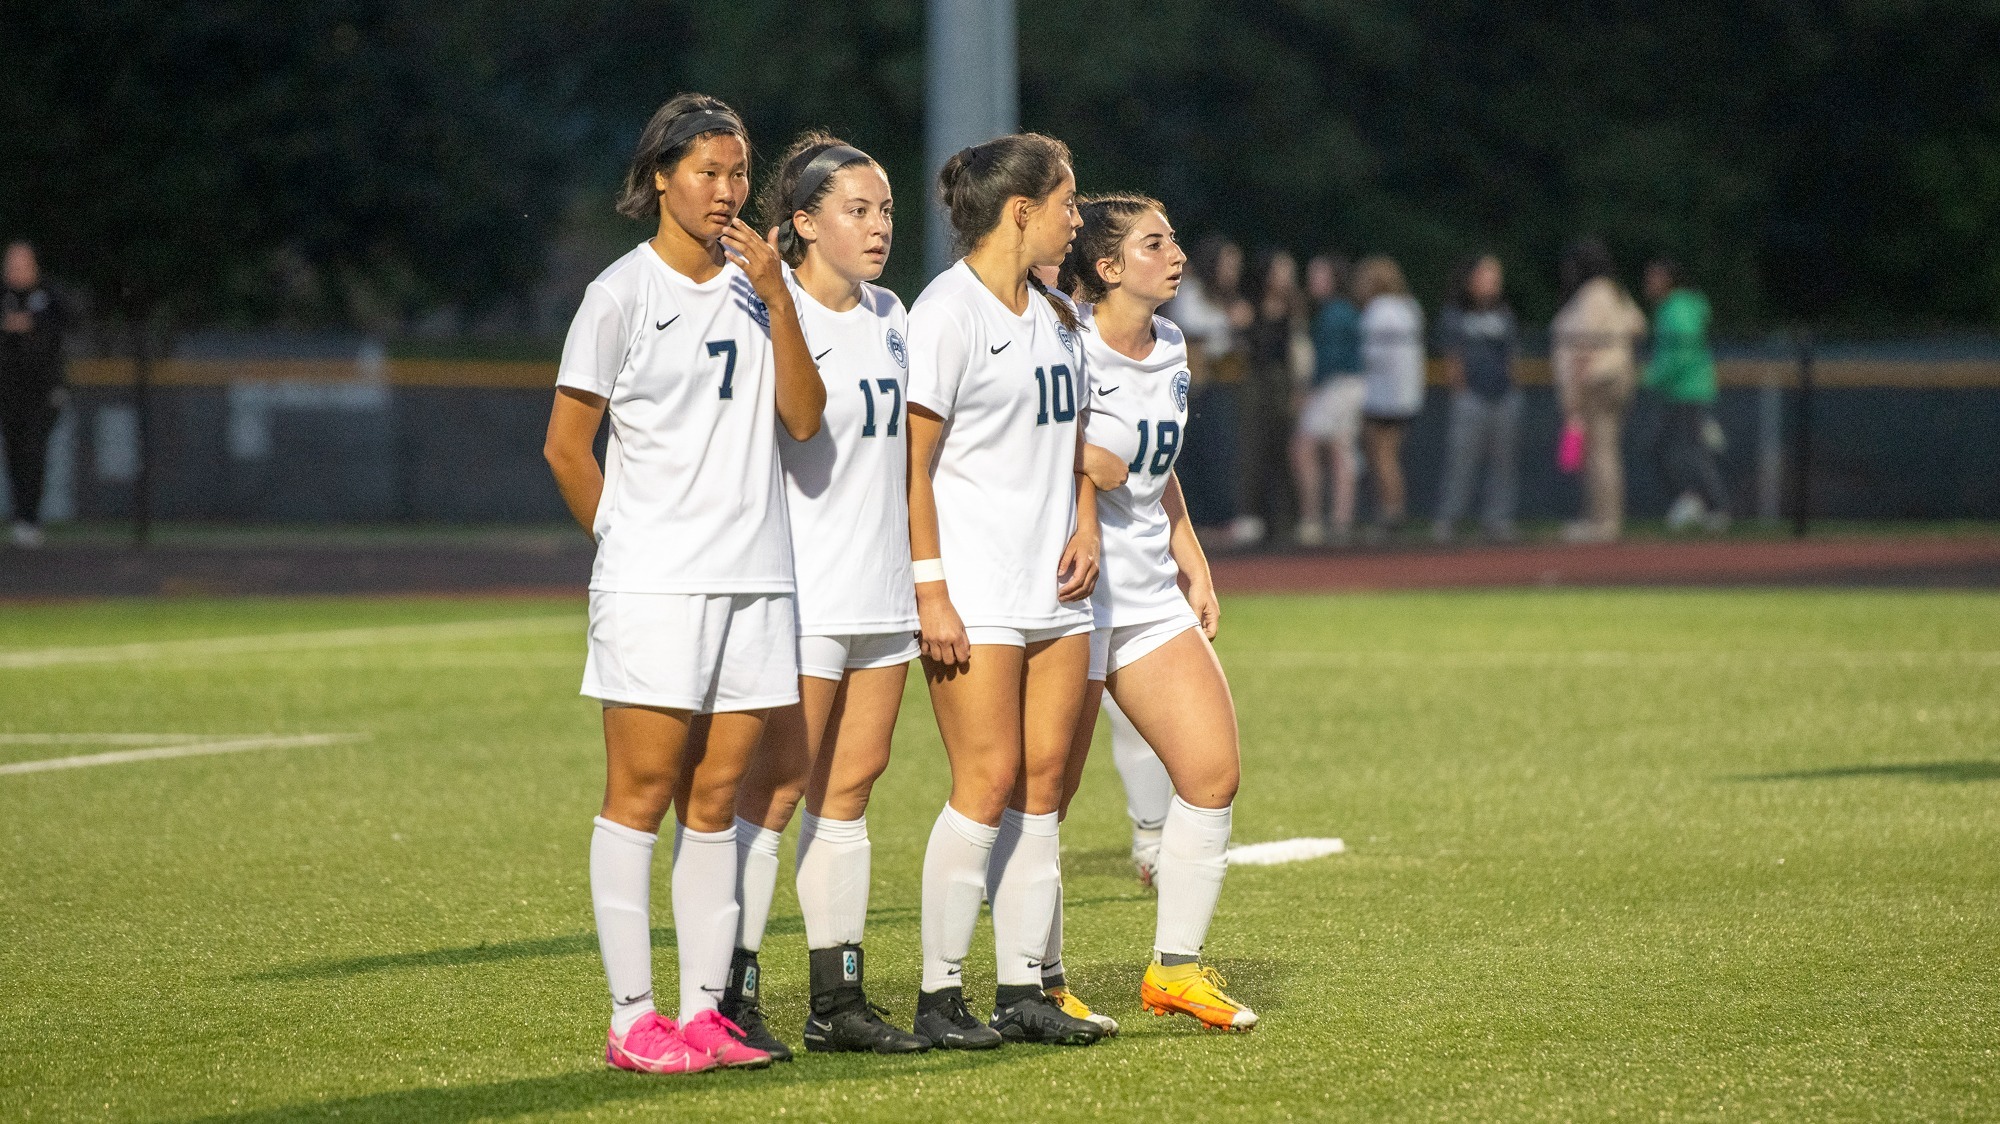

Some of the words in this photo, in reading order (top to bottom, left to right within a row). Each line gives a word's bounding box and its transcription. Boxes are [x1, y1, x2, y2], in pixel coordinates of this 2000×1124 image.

[705, 339, 738, 400] 7
[1034, 363, 1077, 427] 10
[859, 378, 900, 438] 17
[1128, 418, 1179, 475] 18
